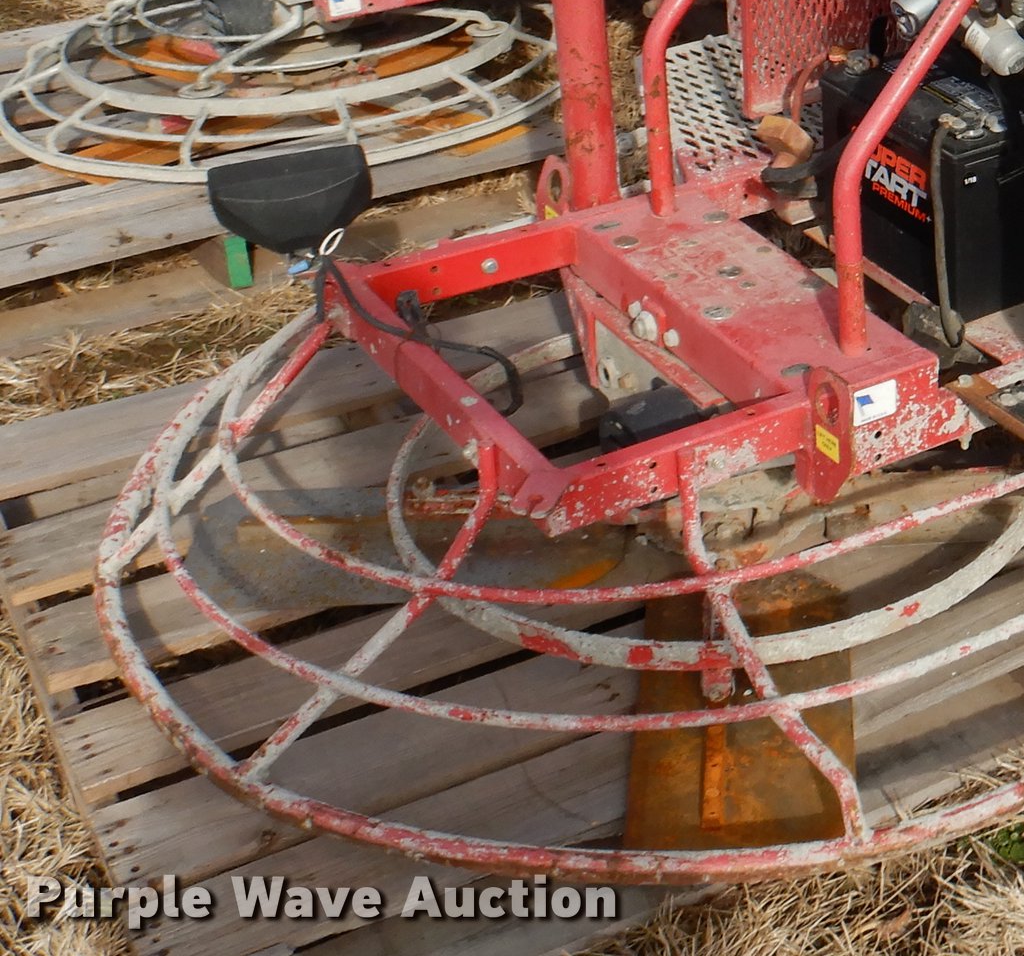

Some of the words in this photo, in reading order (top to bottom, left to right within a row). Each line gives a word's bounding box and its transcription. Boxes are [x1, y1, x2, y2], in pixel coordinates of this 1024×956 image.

[864, 158, 928, 208] TART
[871, 143, 927, 191] UPER
[871, 182, 927, 222] PREMIUM
